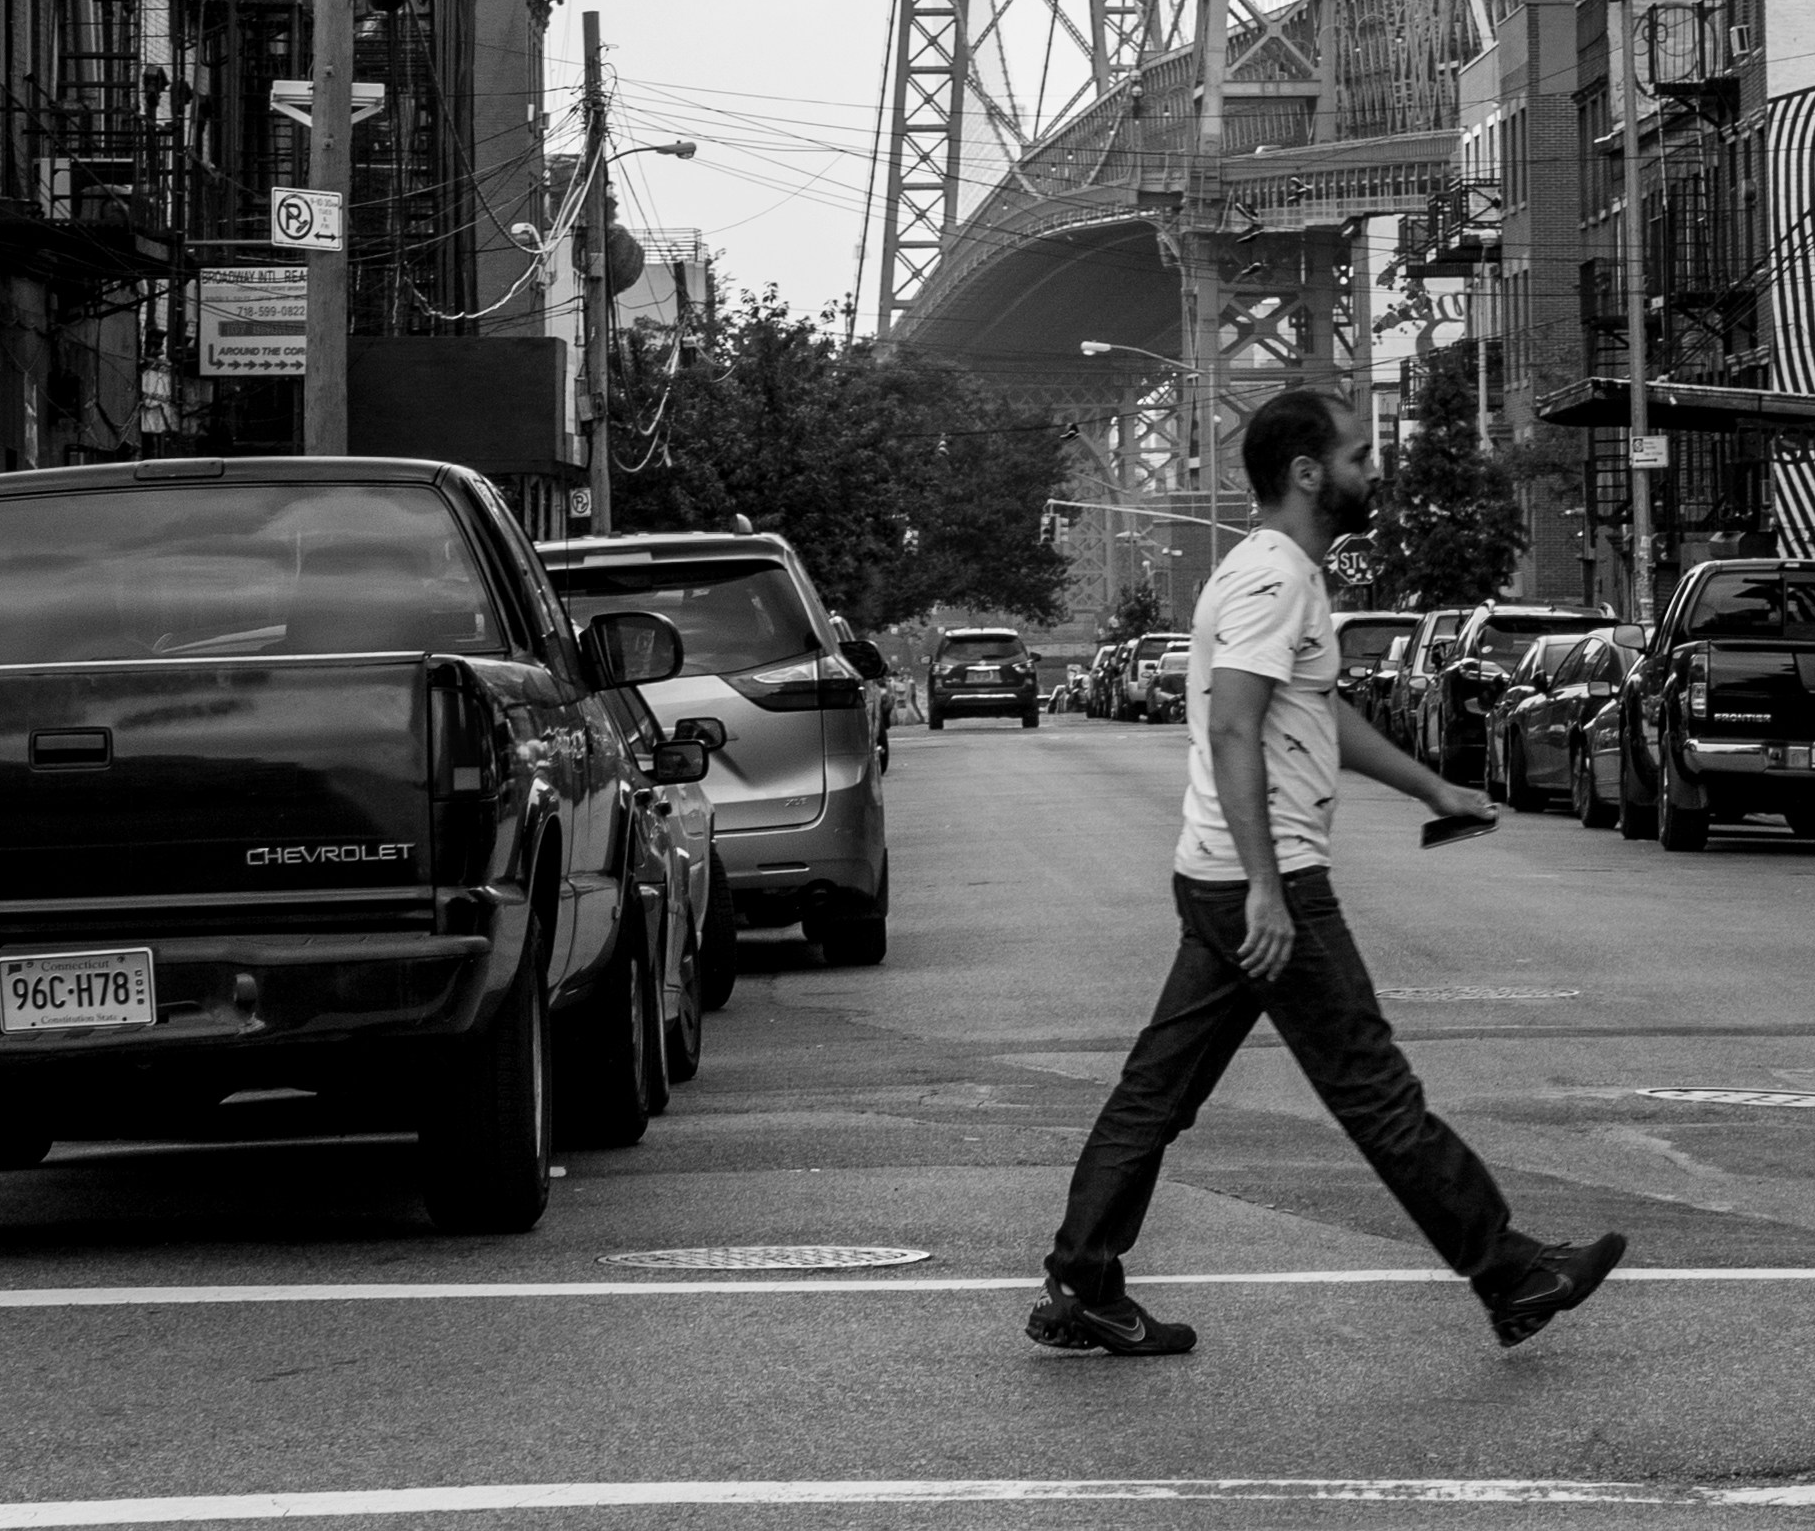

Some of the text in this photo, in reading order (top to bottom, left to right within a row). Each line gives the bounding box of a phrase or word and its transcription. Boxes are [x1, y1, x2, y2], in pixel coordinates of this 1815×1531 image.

[218, 346, 260, 356] AROUND
[262, 346, 282, 356] THE
[1713, 712, 1772, 723] FRONTIER
[246, 843, 416, 865] CHEVROLET
[41, 959, 110, 973] Connecticut
[40, 1012, 118, 1025] Constitution State
